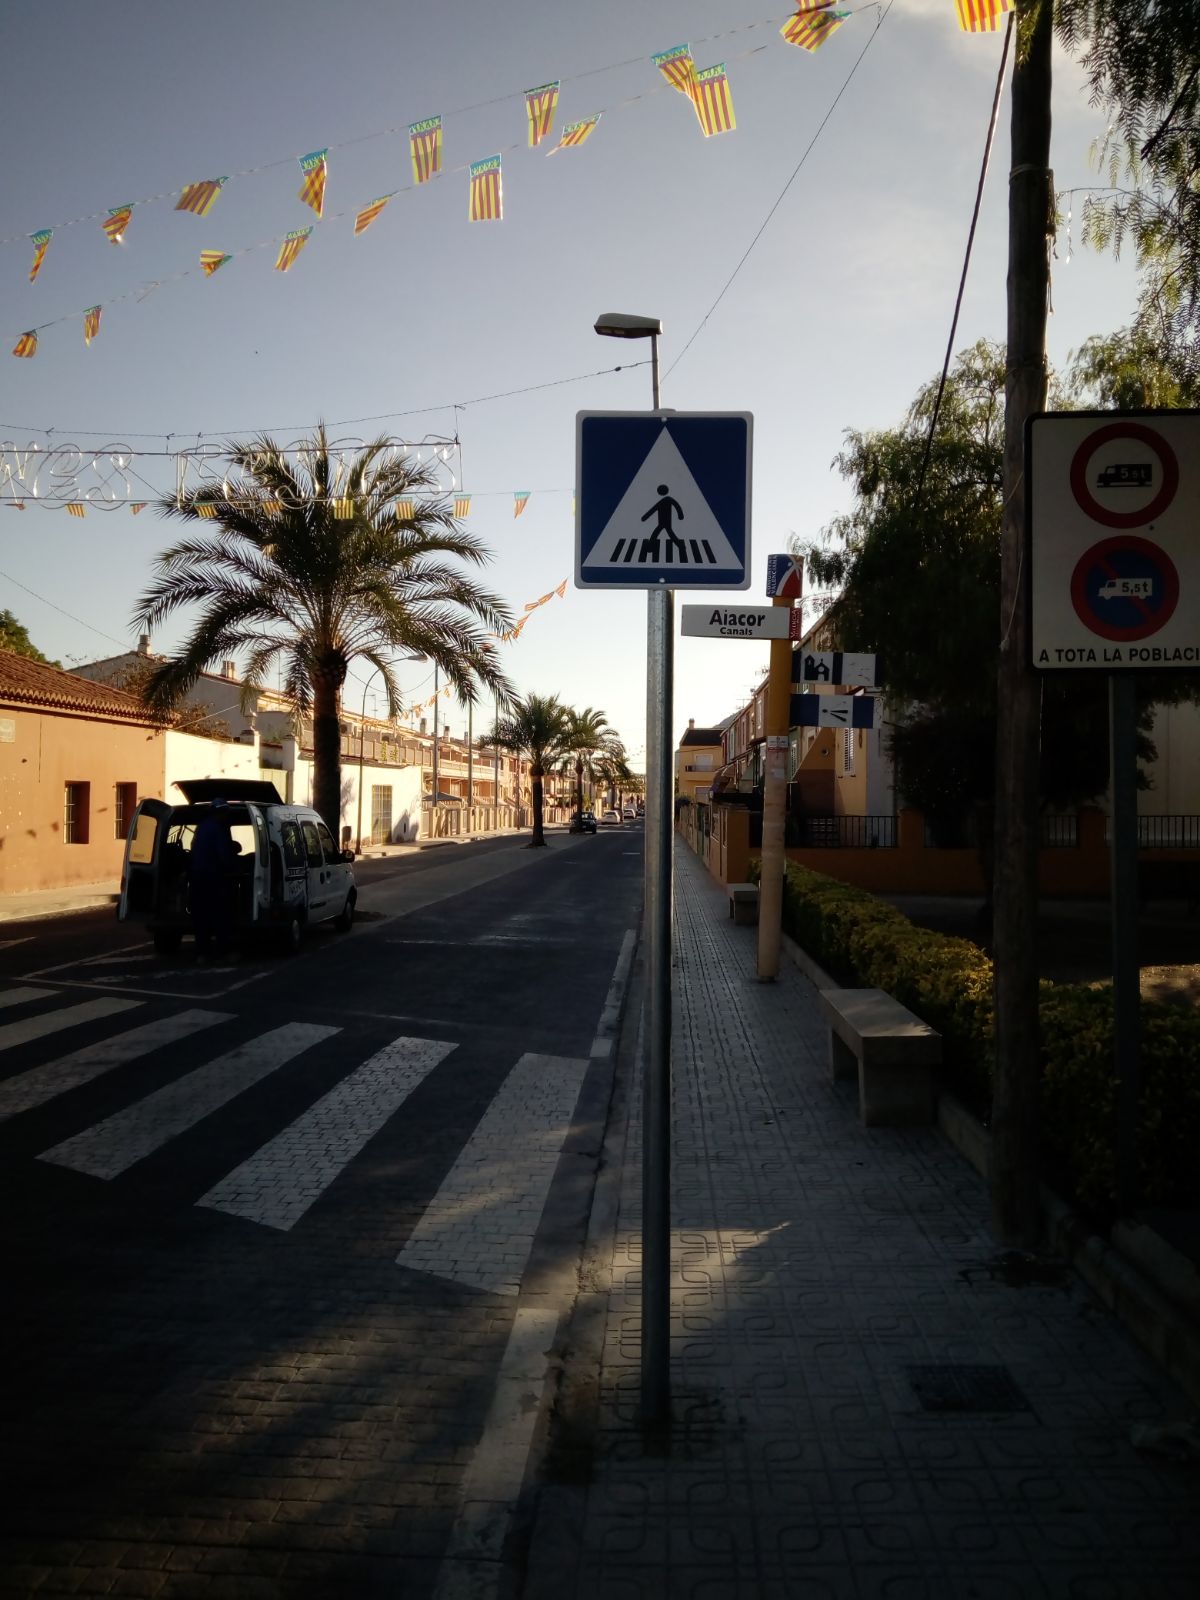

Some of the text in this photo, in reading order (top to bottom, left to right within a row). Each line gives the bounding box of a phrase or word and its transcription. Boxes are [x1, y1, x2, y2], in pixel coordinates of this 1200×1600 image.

[709, 609, 766, 626] Aiacor
[720, 627, 753, 636] Canals
[1039, 647, 1200, 662] A TOTA LA POBLACI
